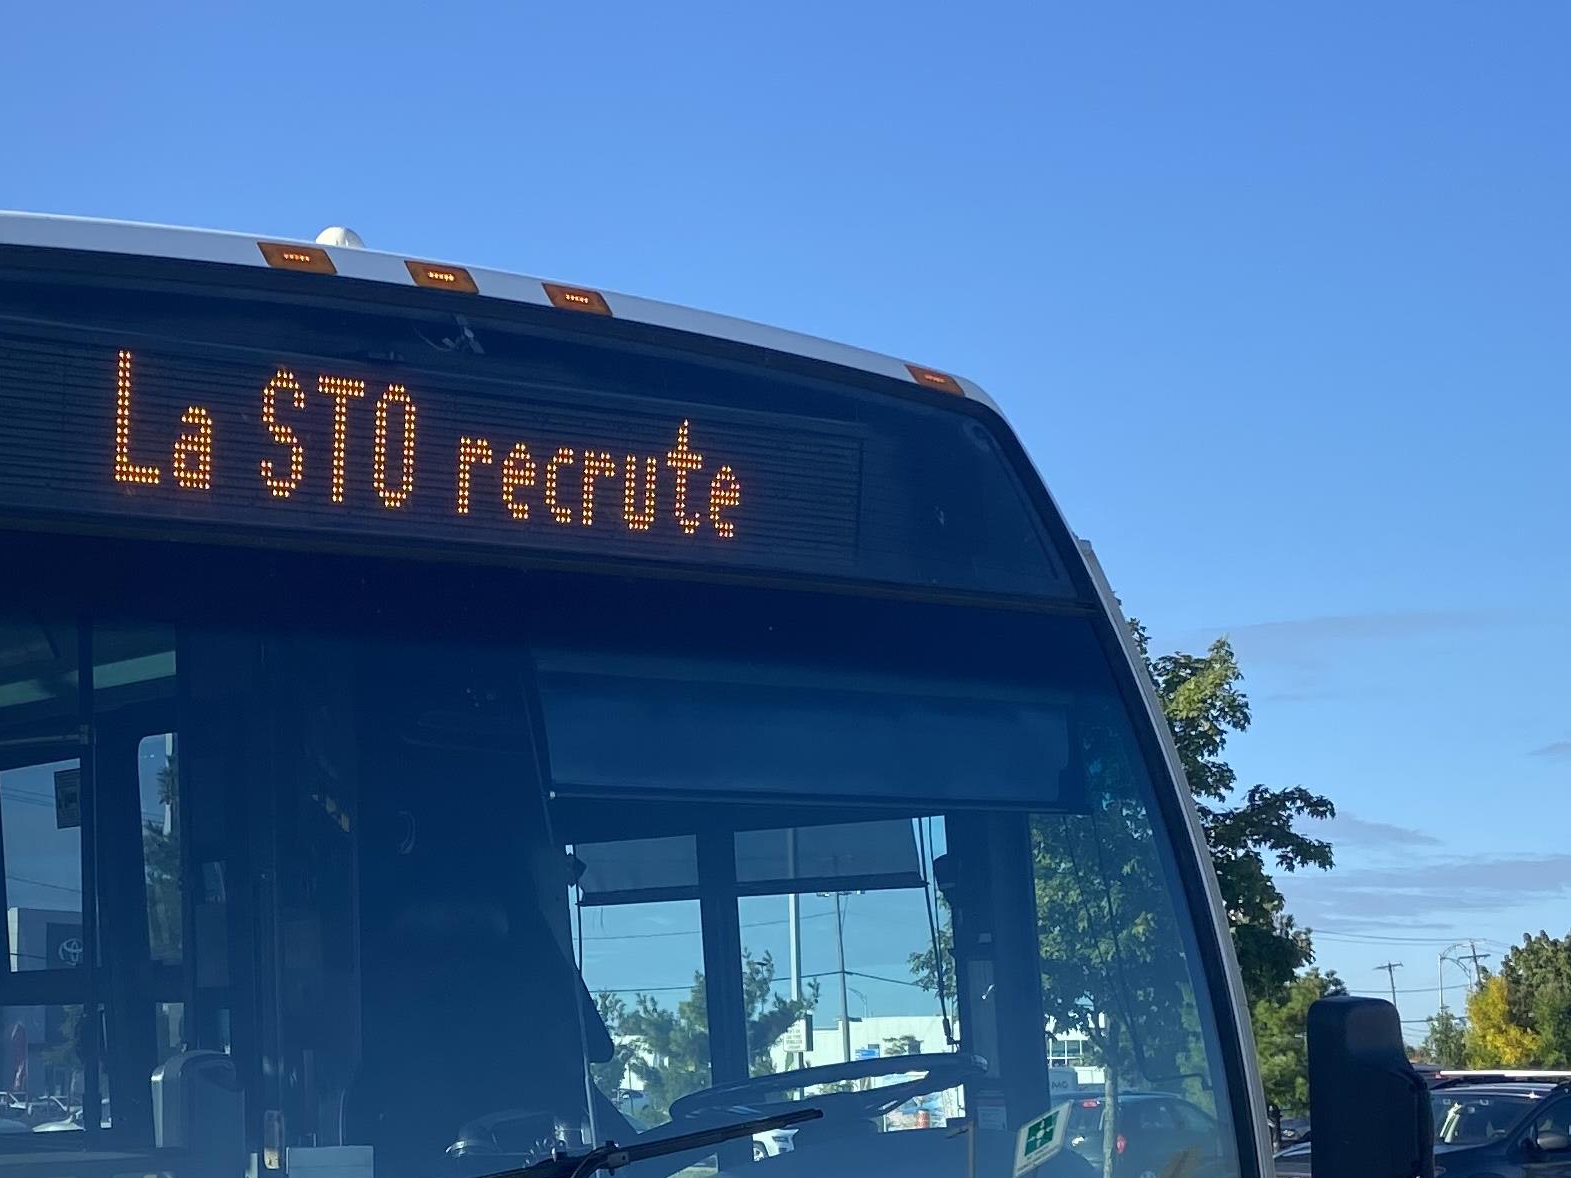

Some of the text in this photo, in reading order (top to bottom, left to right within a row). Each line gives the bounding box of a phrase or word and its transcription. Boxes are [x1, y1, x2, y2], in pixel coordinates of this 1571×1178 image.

[114, 349, 741, 538] La STO recrute
